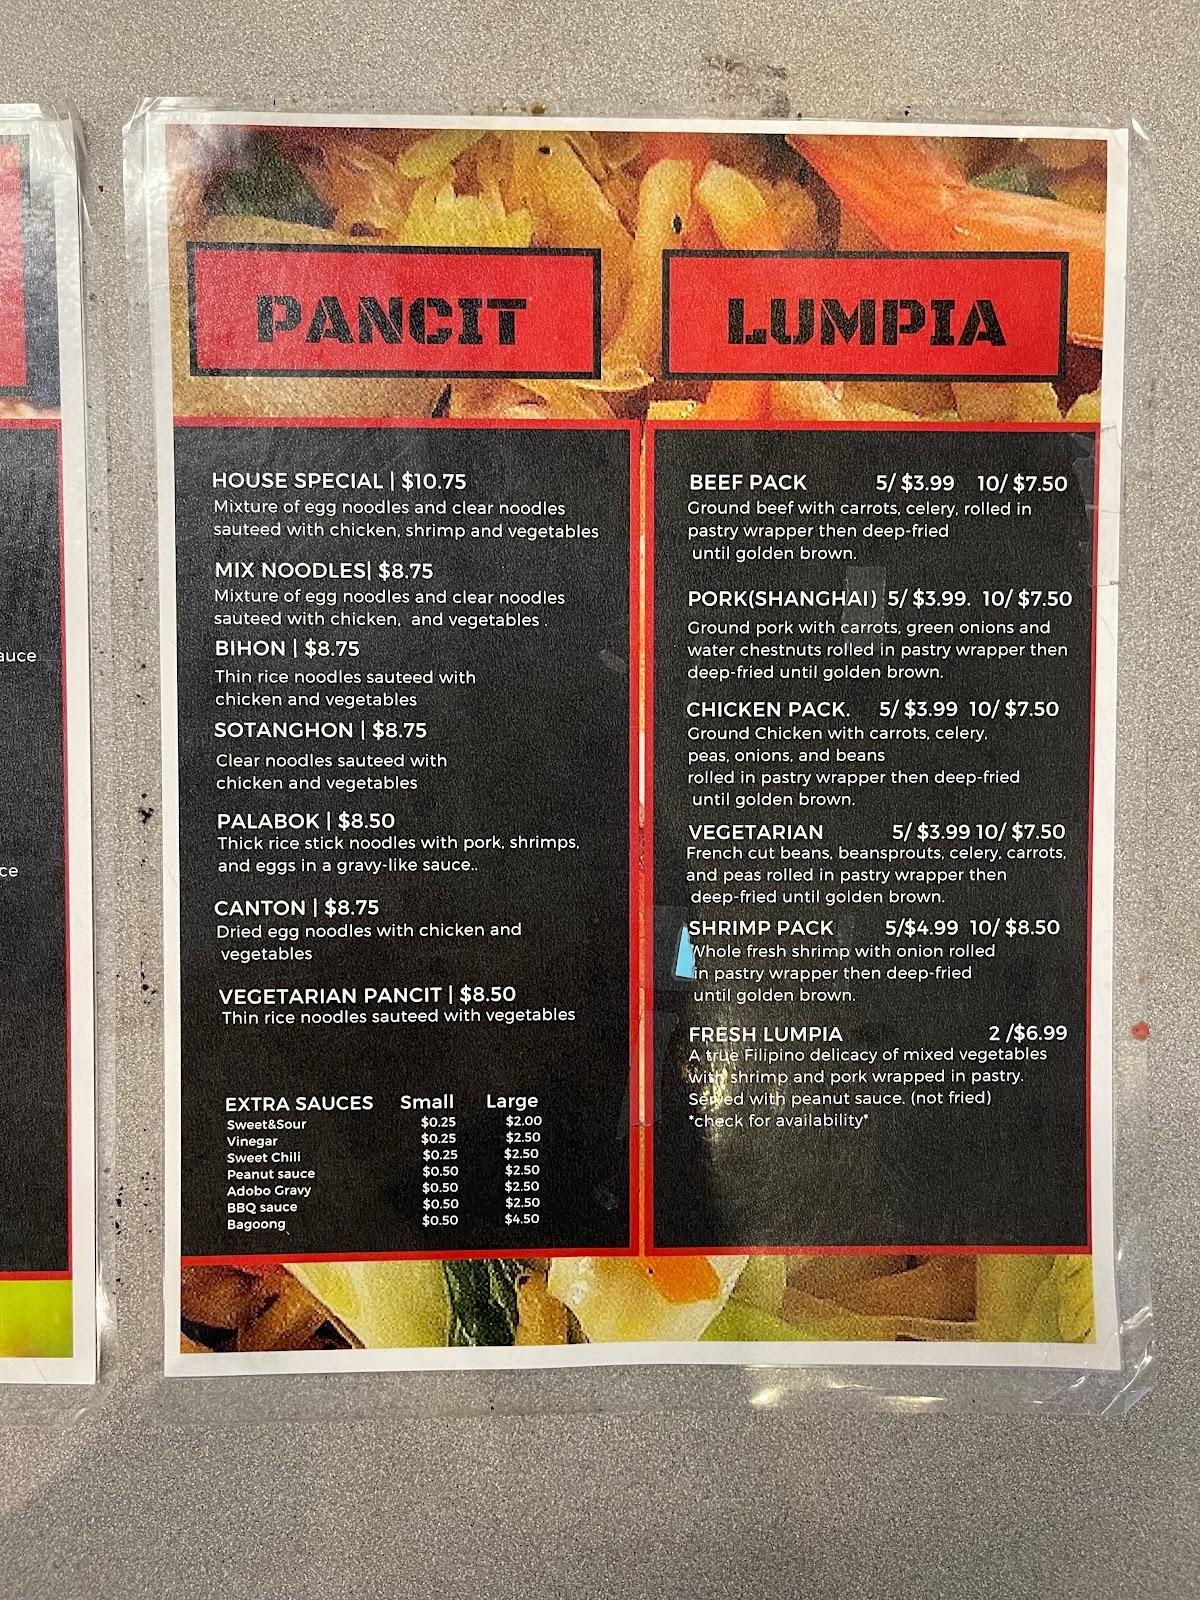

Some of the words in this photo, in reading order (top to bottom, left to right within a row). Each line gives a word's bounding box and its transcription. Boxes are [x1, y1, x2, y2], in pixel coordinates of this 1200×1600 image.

[256, 295, 526, 345] PANCIT
[728, 298, 1006, 346] LUMPIA
[213, 472, 287, 488] HOUSE
[294, 473, 383, 489] SPECIAL
[402, 470, 466, 492] $10.75
[690, 474, 743, 490] BEEF
[750, 474, 807, 490] PACK
[876, 473, 896, 493] 5/
[901, 473, 954, 493] $3.99
[978, 474, 1008, 493] 10/
[1013, 473, 1067, 494] $7.50
[215, 499, 278, 513] Mixture
[283, 499, 300, 513] of
[305, 503, 336, 516] egg
[343, 500, 409, 514] noodles
[415, 500, 446, 514] and
[452, 500, 494, 514] clear
[500, 501, 565, 515] noodles
[688, 500, 750, 514] Ground
[757, 500, 794, 514] beef
[798, 501, 834, 514] with
[840, 503, 900, 516] carrots,
[906, 501, 958, 518] celery,
[965, 502, 1010, 515] rolled
[1017, 502, 1031, 515] in
[214, 522, 281, 536] sauteed
[286, 522, 324, 536] with
[330, 523, 400, 538] chicken,
[406, 523, 465, 540] shrimp
[471, 524, 502, 537] and
[508, 524, 598, 541] vegetables
[216, 562, 254, 578] MIX
[379, 560, 433, 581] $8.75
[689, 590, 876, 609] PORK(SHANGHAI)
[887, 588, 908, 608] 5/
[983, 589, 1013, 608] 10/
[1018, 588, 1072, 609] $7.50
[688, 620, 749, 634] Ground
[757, 620, 793, 637] pork
[798, 620, 835, 634] with
[841, 622, 901, 635] carrots,
[907, 624, 953, 637] green
[960, 621, 1014, 634] onions
[1019, 620, 1050, 634] and
[216, 640, 285, 656] BIHON
[305, 638, 359, 659] $8.75
[215, 669, 251, 683] Thin
[258, 670, 288, 683] rice
[295, 670, 361, 683] noodles
[367, 670, 433, 684] sauteed
[439, 670, 475, 684] with
[687, 702, 780, 717] CHICKEN
[789, 702, 850, 717] PACK.
[880, 699, 899, 719] 5/
[904, 699, 957, 719] $3.99
[969, 699, 1000, 719] 10/
[1005, 699, 1059, 719] $7.50
[214, 722, 352, 738] SOTANGHON
[372, 720, 427, 740] $8.75
[216, 753, 260, 767] Clear
[266, 754, 332, 767] noodles
[338, 754, 404, 767] sauteed
[410, 754, 447, 767] with
[218, 813, 320, 829] PALABOK
[338, 811, 395, 831] $8.50
[689, 825, 822, 840] VEGETARIAN
[893, 822, 912, 842] 5/
[917, 822, 970, 842] $3.99
[976, 822, 1007, 841] 10/
[1012, 822, 1065, 842] $7.50
[217, 836, 263, 850] Thick
[269, 836, 299, 849] rice
[305, 836, 344, 849] stick
[350, 836, 415, 849] noodles
[421, 835, 457, 849] with
[464, 835, 504, 852] pork,
[510, 835, 579, 851] shrimps,
[687, 846, 742, 859] French
[748, 847, 775, 859] cut
[781, 846, 832, 860] beans,
[839, 846, 944, 862] beansprouts,
[950, 846, 1001, 862] celery,
[1007, 847, 1066, 859] carrots,
[215, 900, 305, 916] CANTON
[325, 897, 379, 918] $8.75
[217, 925, 261, 938] Dried
[268, 928, 299, 941] egg
[306, 924, 371, 937] noodles
[377, 923, 413, 937] with
[419, 923, 484, 936] chicken
[490, 922, 521, 936] and
[689, 920, 770, 935] SHRIMP
[778, 920, 833, 935] PACK
[885, 918, 958, 938] 5/$4.99
[970, 918, 1000, 937] 10/
[1005, 917, 1060, 937] $8.50
[221, 947, 312, 963] vegetables
[219, 988, 356, 1004] VEGETARIAN
[365, 987, 442, 1003] PANCIT
[460, 984, 516, 1005] $8.50
[222, 1011, 258, 1024] Thin
[265, 1011, 295, 1024] rice
[301, 1010, 367, 1023] noodles
[372, 1009, 438, 1023] sauteed
[444, 1008, 480, 1022] with
[486, 1008, 575, 1024] vegetables
[689, 1026, 756, 1042] FRESH
[764, 1027, 843, 1042] LUMPIA
[989, 1026, 1000, 1040] 2
[1006, 1023, 1067, 1043] /$6.99
[689, 1049, 700, 1062] A
[706, 1049, 739, 1062] true
[745, 1048, 804, 1064] Filipino
[810, 1048, 877, 1064] delicacy
[883, 1048, 899, 1061] of
[904, 1047, 953, 1060] mixed
[959, 1047, 1047, 1063] vegetables
[226, 1097, 290, 1111] EXTRA
[296, 1096, 373, 1111] SAUCES
[400, 1094, 453, 1109] Small
[487, 1094, 538, 1111] Large
[227, 1119, 306, 1130] Sweet&Sour
[421, 1116, 456, 1129] $0.25
[506, 1115, 542, 1127] $2.00
[227, 1136, 278, 1148] Vinegar
[421, 1132, 456, 1145] $0.25
[506, 1131, 540, 1144] $2.50
[227, 1153, 268, 1163] Sweet
[271, 1151, 300, 1162] Chili
[423, 1149, 458, 1161] $0.25
[504, 1148, 539, 1160] $2.50
[228, 1169, 274, 1180] Peanut
[278, 1170, 315, 1179] sauce
[423, 1165, 458, 1178] $0.50
[505, 1164, 540, 1177] $2.50
[227, 1185, 271, 1196] Adobo
[275, 1185, 311, 1197] Gravy
[422, 1182, 458, 1194] $0.50
[505, 1180, 539, 1193] $2.50
[228, 1203, 256, 1214] BBQ
[260, 1204, 297, 1212] sauce
[423, 1198, 459, 1211] $0.50
[506, 1196, 540, 1209] $2.50
[228, 1219, 285, 1232] Bagoong
[422, 1214, 458, 1227] $0.50
[505, 1213, 539, 1226] $4.50
